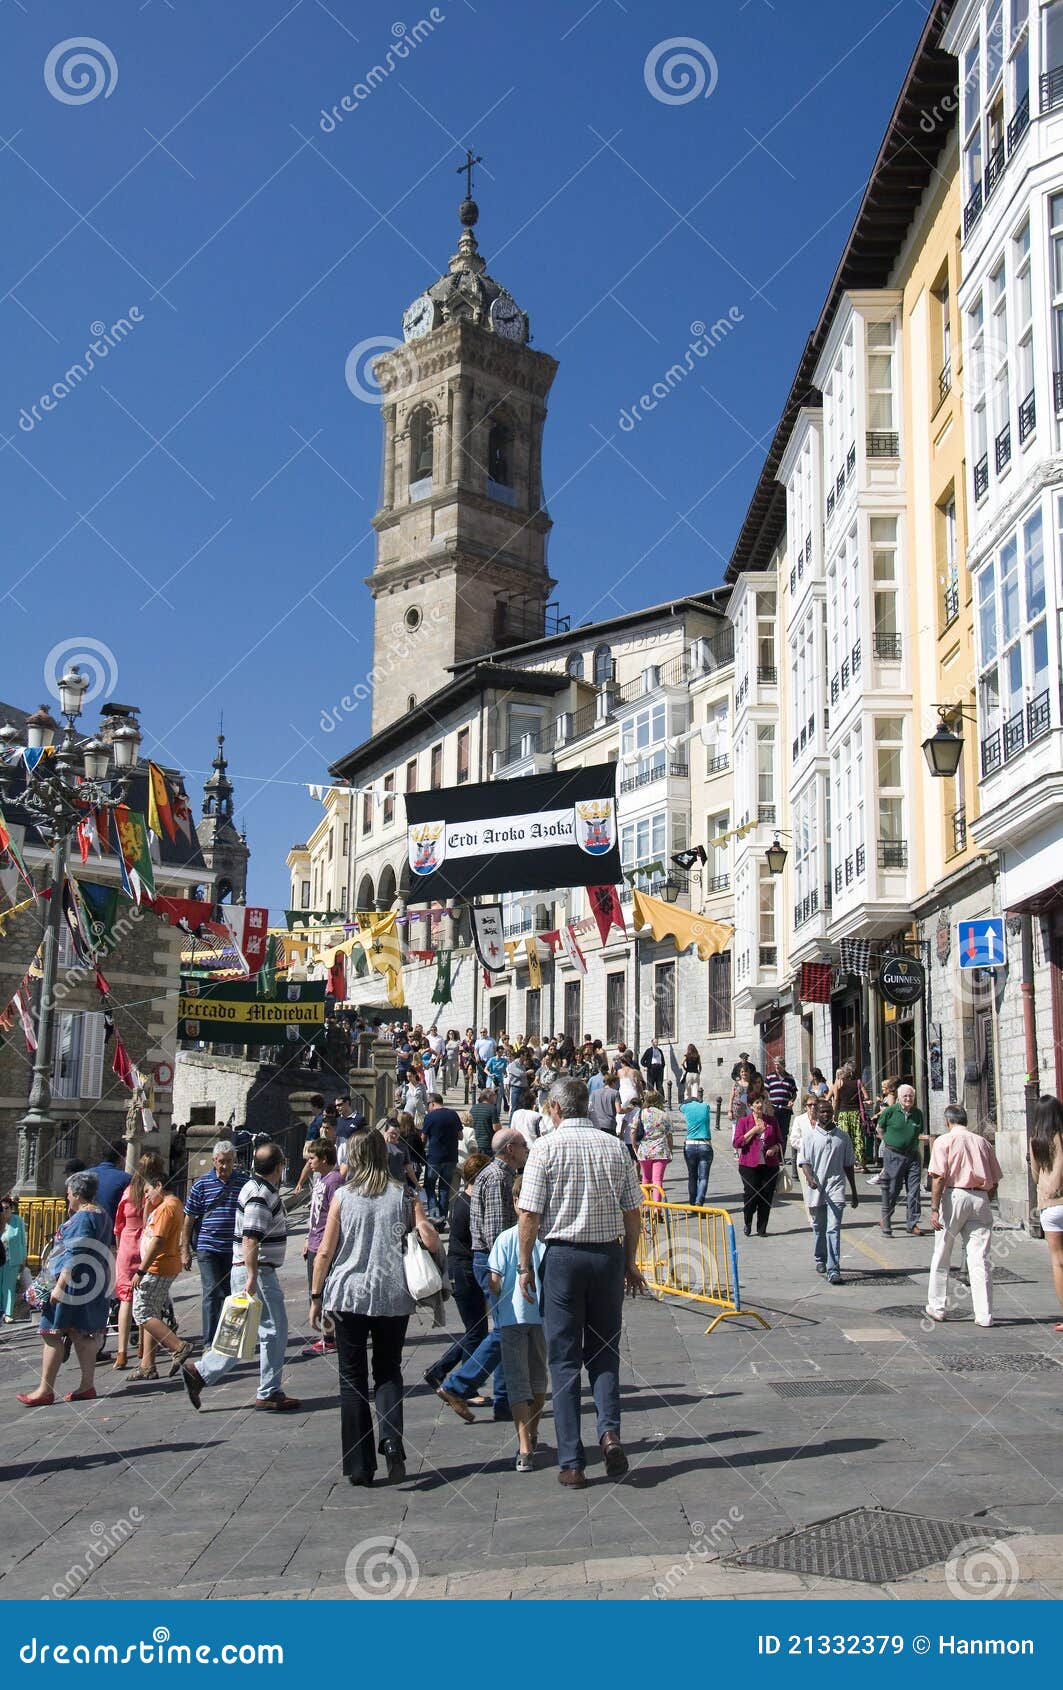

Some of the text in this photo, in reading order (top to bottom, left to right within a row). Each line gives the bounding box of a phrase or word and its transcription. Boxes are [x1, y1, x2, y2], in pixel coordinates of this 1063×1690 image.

[448, 820, 573, 848] Erdi Aroko Azoka
[883, 973, 921, 985] GUINNESS
[245, 1004, 319, 1021] Medieval
